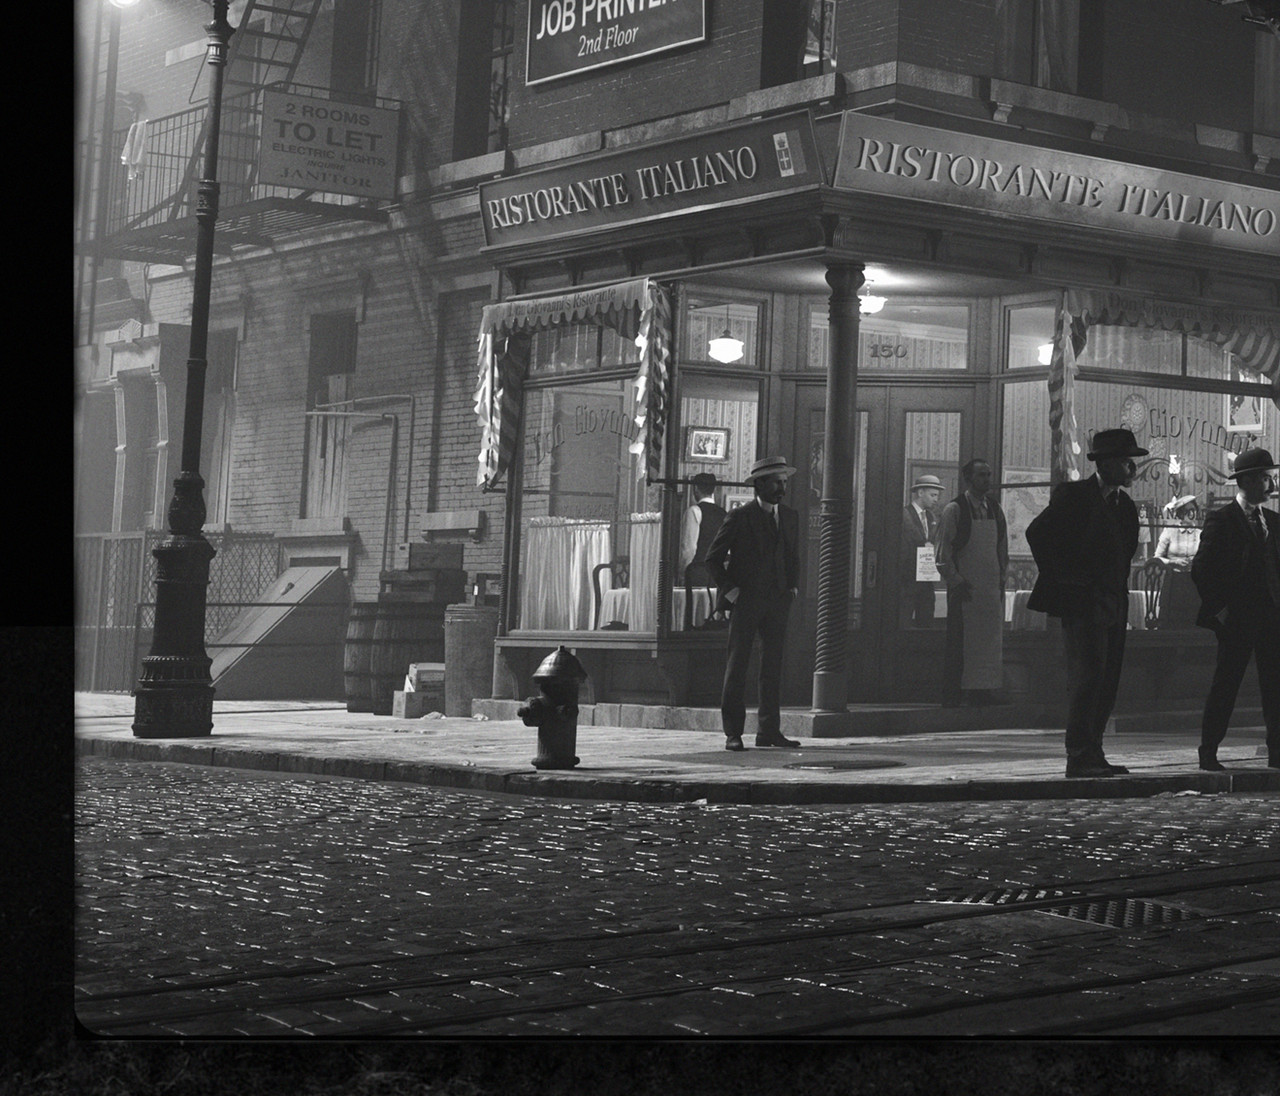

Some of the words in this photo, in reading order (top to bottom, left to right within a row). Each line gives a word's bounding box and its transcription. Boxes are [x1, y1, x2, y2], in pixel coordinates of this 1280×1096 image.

[577, 32, 603, 58] 2nd
[605, 23, 639, 51] Floor
[286, 102, 296, 115] 2
[302, 105, 370, 126] ROOMS
[273, 118, 316, 142] TO
[326, 127, 383, 152] LET
[272, 142, 336, 160] ELECTRIC
[341, 152, 386, 168] LIGHTS
[280, 167, 371, 188] JANITOR
[487, 177, 629, 230] RISTORANTE
[636, 145, 758, 201] ITALIANO
[855, 136, 1105, 209] RISTORANTE
[1117, 183, 1278, 238] ITALIANO
[869, 342, 908, 358] 150
